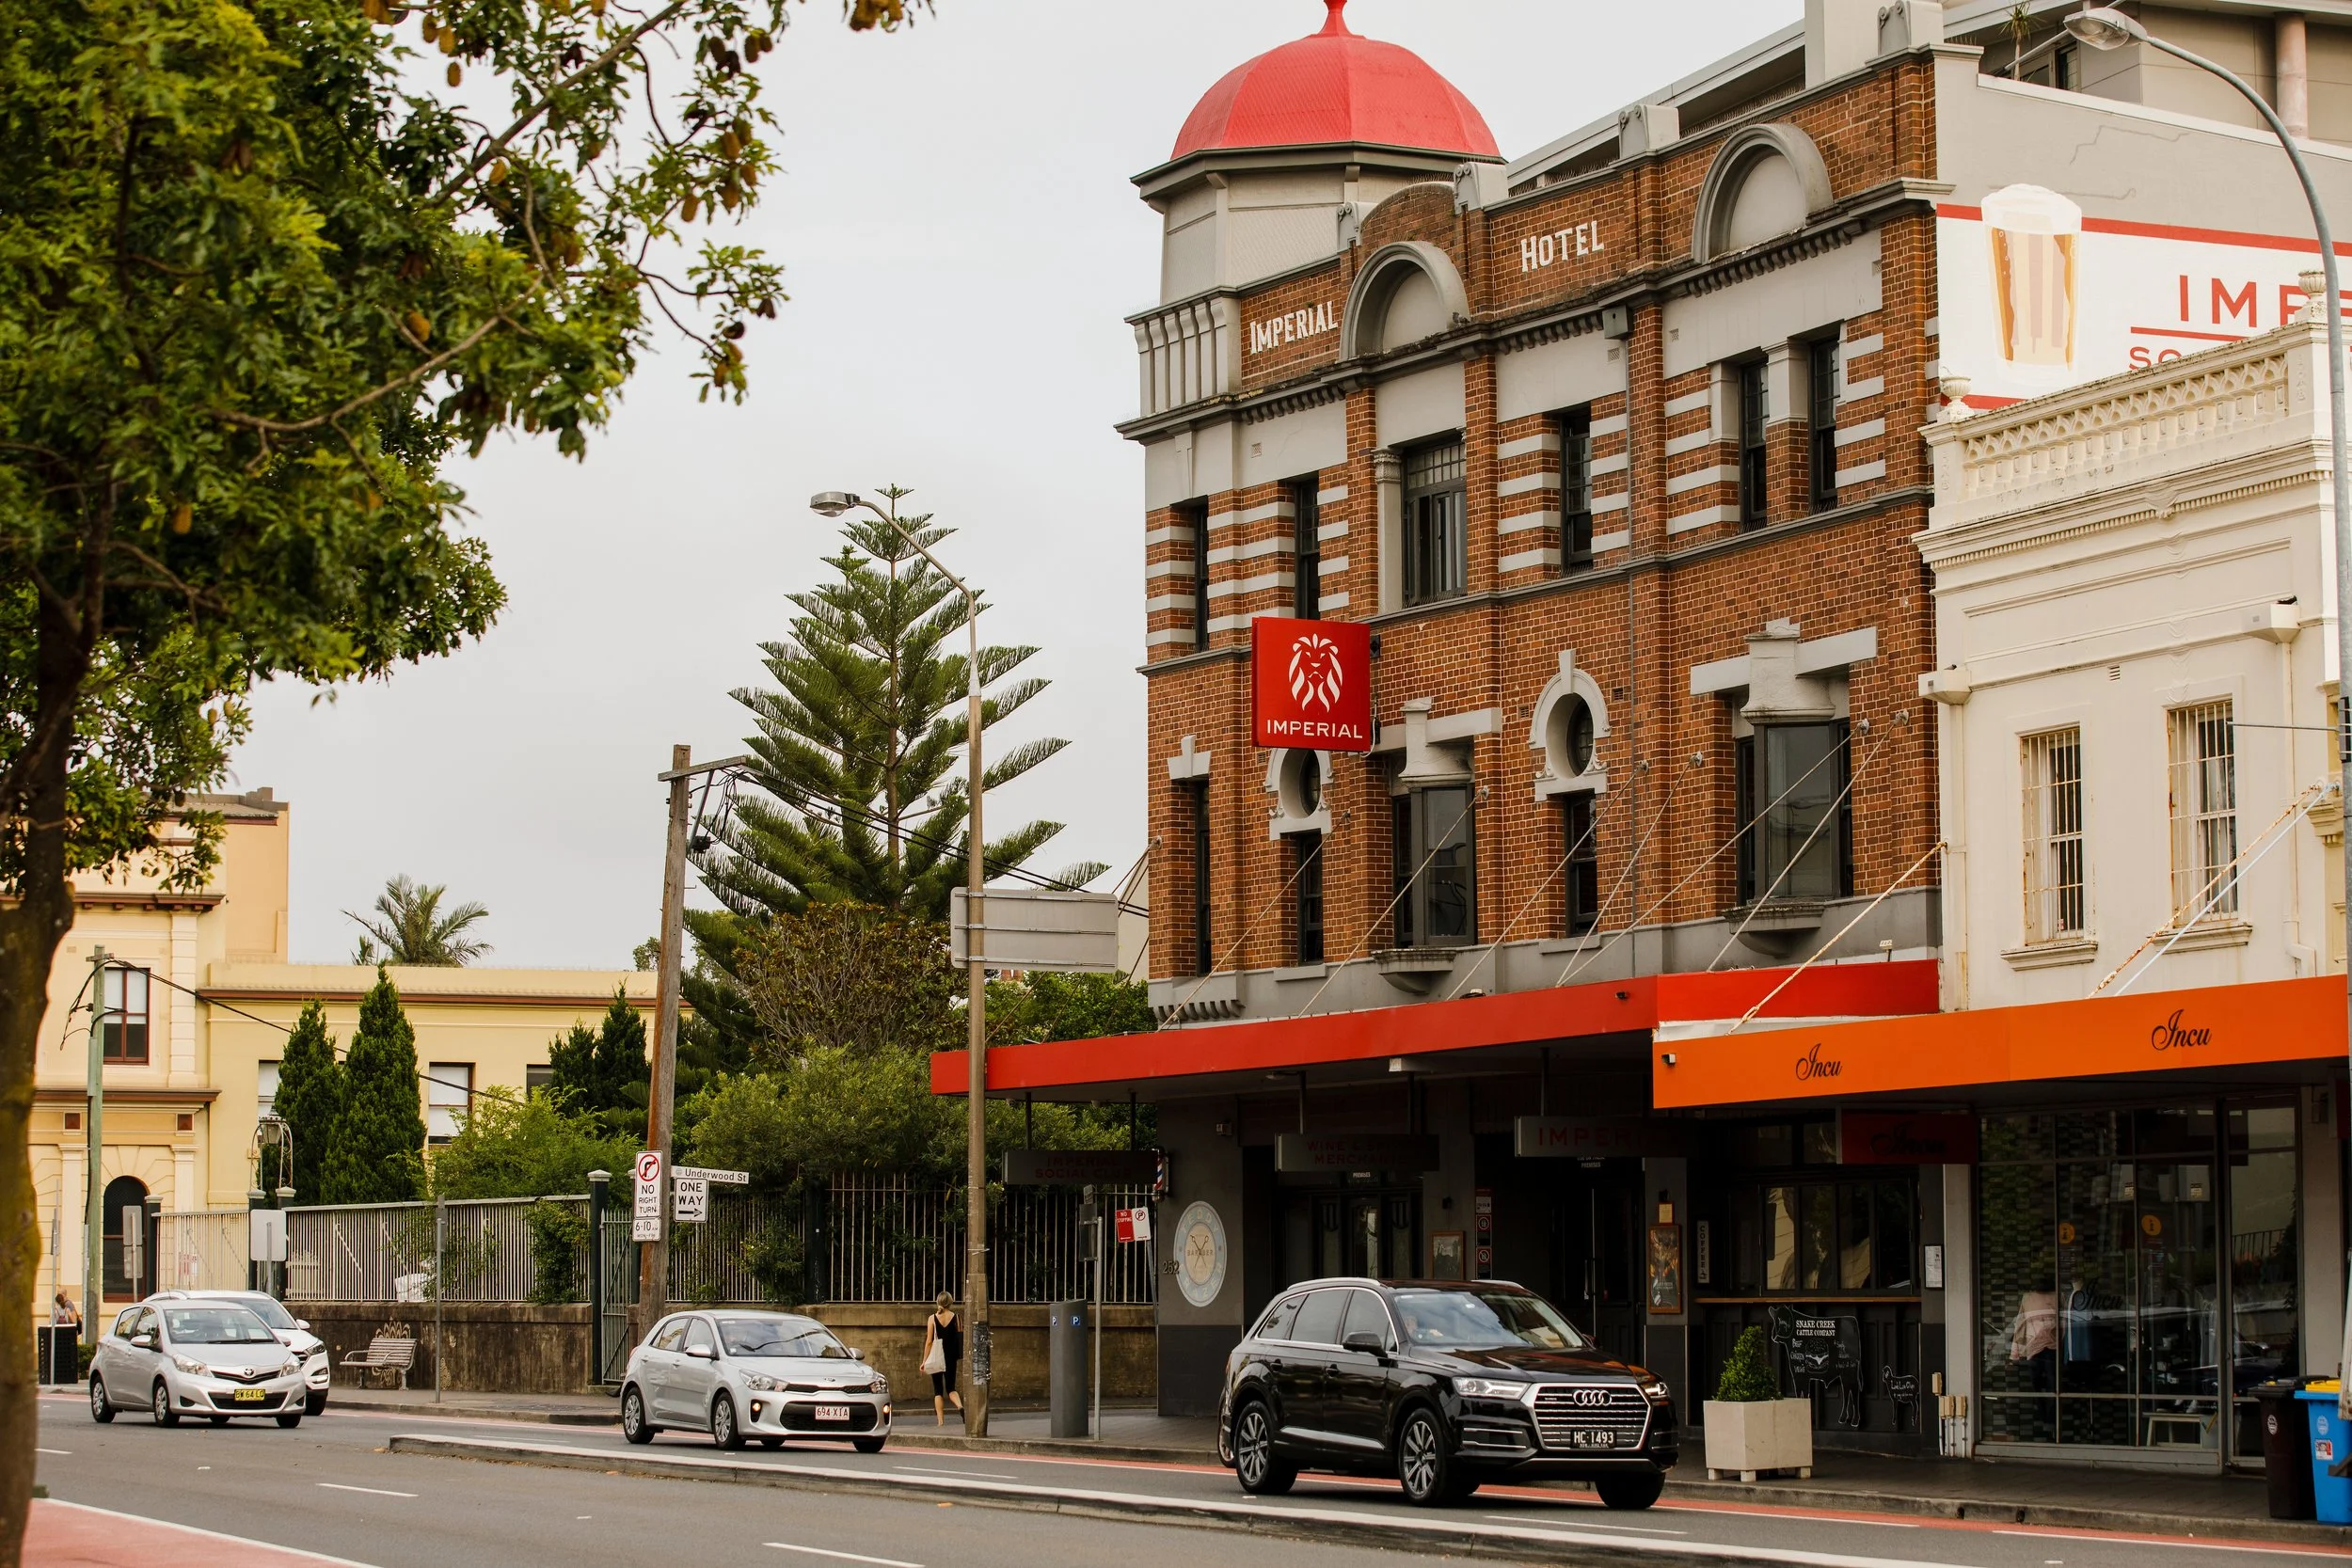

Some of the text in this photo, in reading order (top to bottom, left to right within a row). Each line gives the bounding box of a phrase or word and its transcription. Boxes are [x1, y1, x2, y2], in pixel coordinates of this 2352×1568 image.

[1521, 220, 1604, 273] HOTEL
[1250, 301, 1338, 355] IMPERIAL
[1266, 719, 1363, 738] IMPERIAL
[2152, 1008, 2212, 1051] Incu
[1796, 1043, 1843, 1081] Incu
[1047, 1157, 1119, 1166] IMPERIAL
[685, 1168, 746, 1182] Underwood St
[1035, 1168, 1089, 1179] SOCIAL
[642, 1184, 655, 1195] NO
[680, 1182, 703, 1193] ONE
[678, 1196, 704, 1205] WAY
[636, 1221, 652, 1231] 6-10
[1163, 1260, 1180, 1275] 252
[1795, 1320, 1816, 1328] SNAKE
[1816, 1320, 1836, 1328] CREEK
